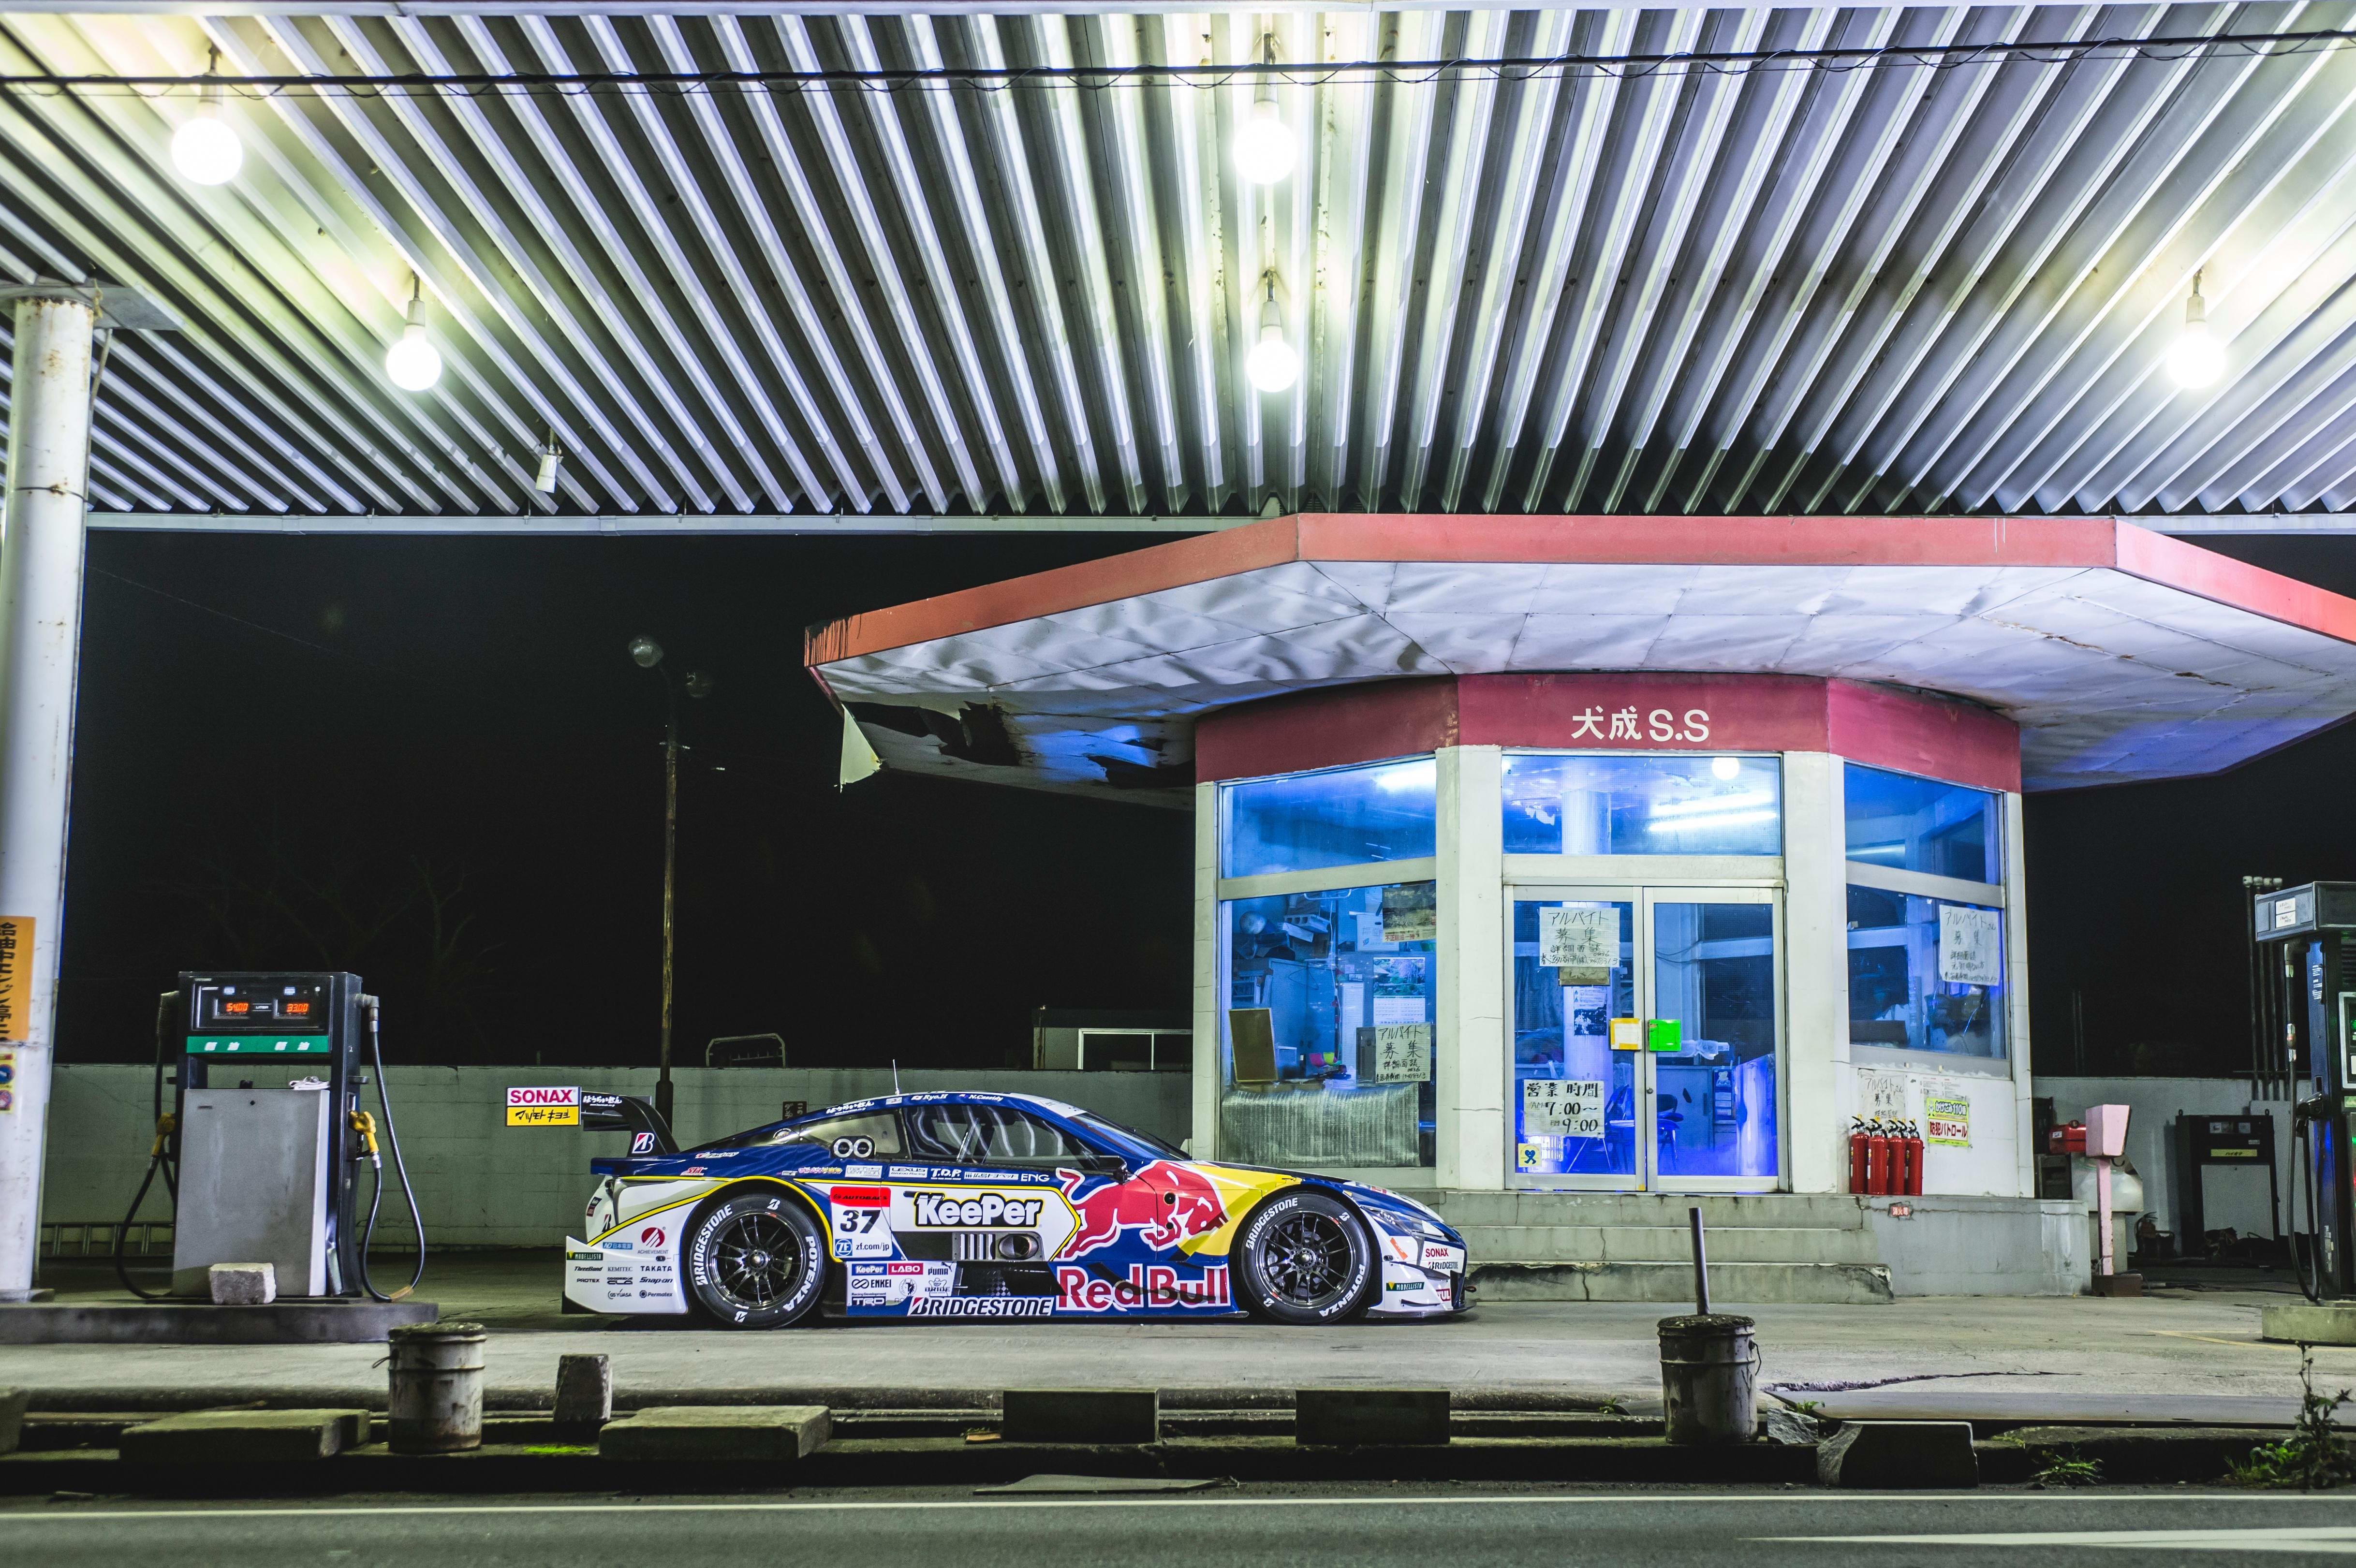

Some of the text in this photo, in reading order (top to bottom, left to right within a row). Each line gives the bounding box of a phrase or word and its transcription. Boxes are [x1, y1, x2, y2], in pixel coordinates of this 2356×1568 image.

[1548, 911, 1609, 925] アルバイト
[1945, 912, 1987, 928] アルバイト
[1378, 1025, 1422, 1040] アルバイト
[1383, 1040, 1422, 1059] 募集
[1527, 1083, 1598, 1098] 営業時間
[1865, 1078, 1894, 1091] アルバイト
[510, 1089, 573, 1103] SONAX
[1875, 1093, 1893, 1106] 募集
[1562, 1118, 1598, 1133] 9:00
[1929, 1121, 1967, 1138] 防犯パトロール
[1021, 1173, 1050, 1182] ENG
[916, 1195, 1041, 1225] KeePer
[840, 1210, 881, 1233] 37
[1246, 1198, 1298, 1250] BRIDGESTONE
[693, 1204, 733, 1286] BRIDGESTONE
[838, 1242, 889, 1252] ZF zf.com/jp
[1426, 1248, 1449, 1257] SONAX
[855, 1265, 884, 1274] KeePer
[928, 1267, 948, 1275] PUMA
[1428, 1261, 1458, 1270] BRIDGESTONE
[782, 1236, 817, 1311] POTENZA
[870, 1279, 891, 1288] ENKEI
[1059, 1264, 1229, 1309] Red Bull
[1319, 1264, 1365, 1317] POTENZA
[617, 1289, 632, 1297] YUASA
[910, 1298, 1052, 1315] BRIDGESTONE
